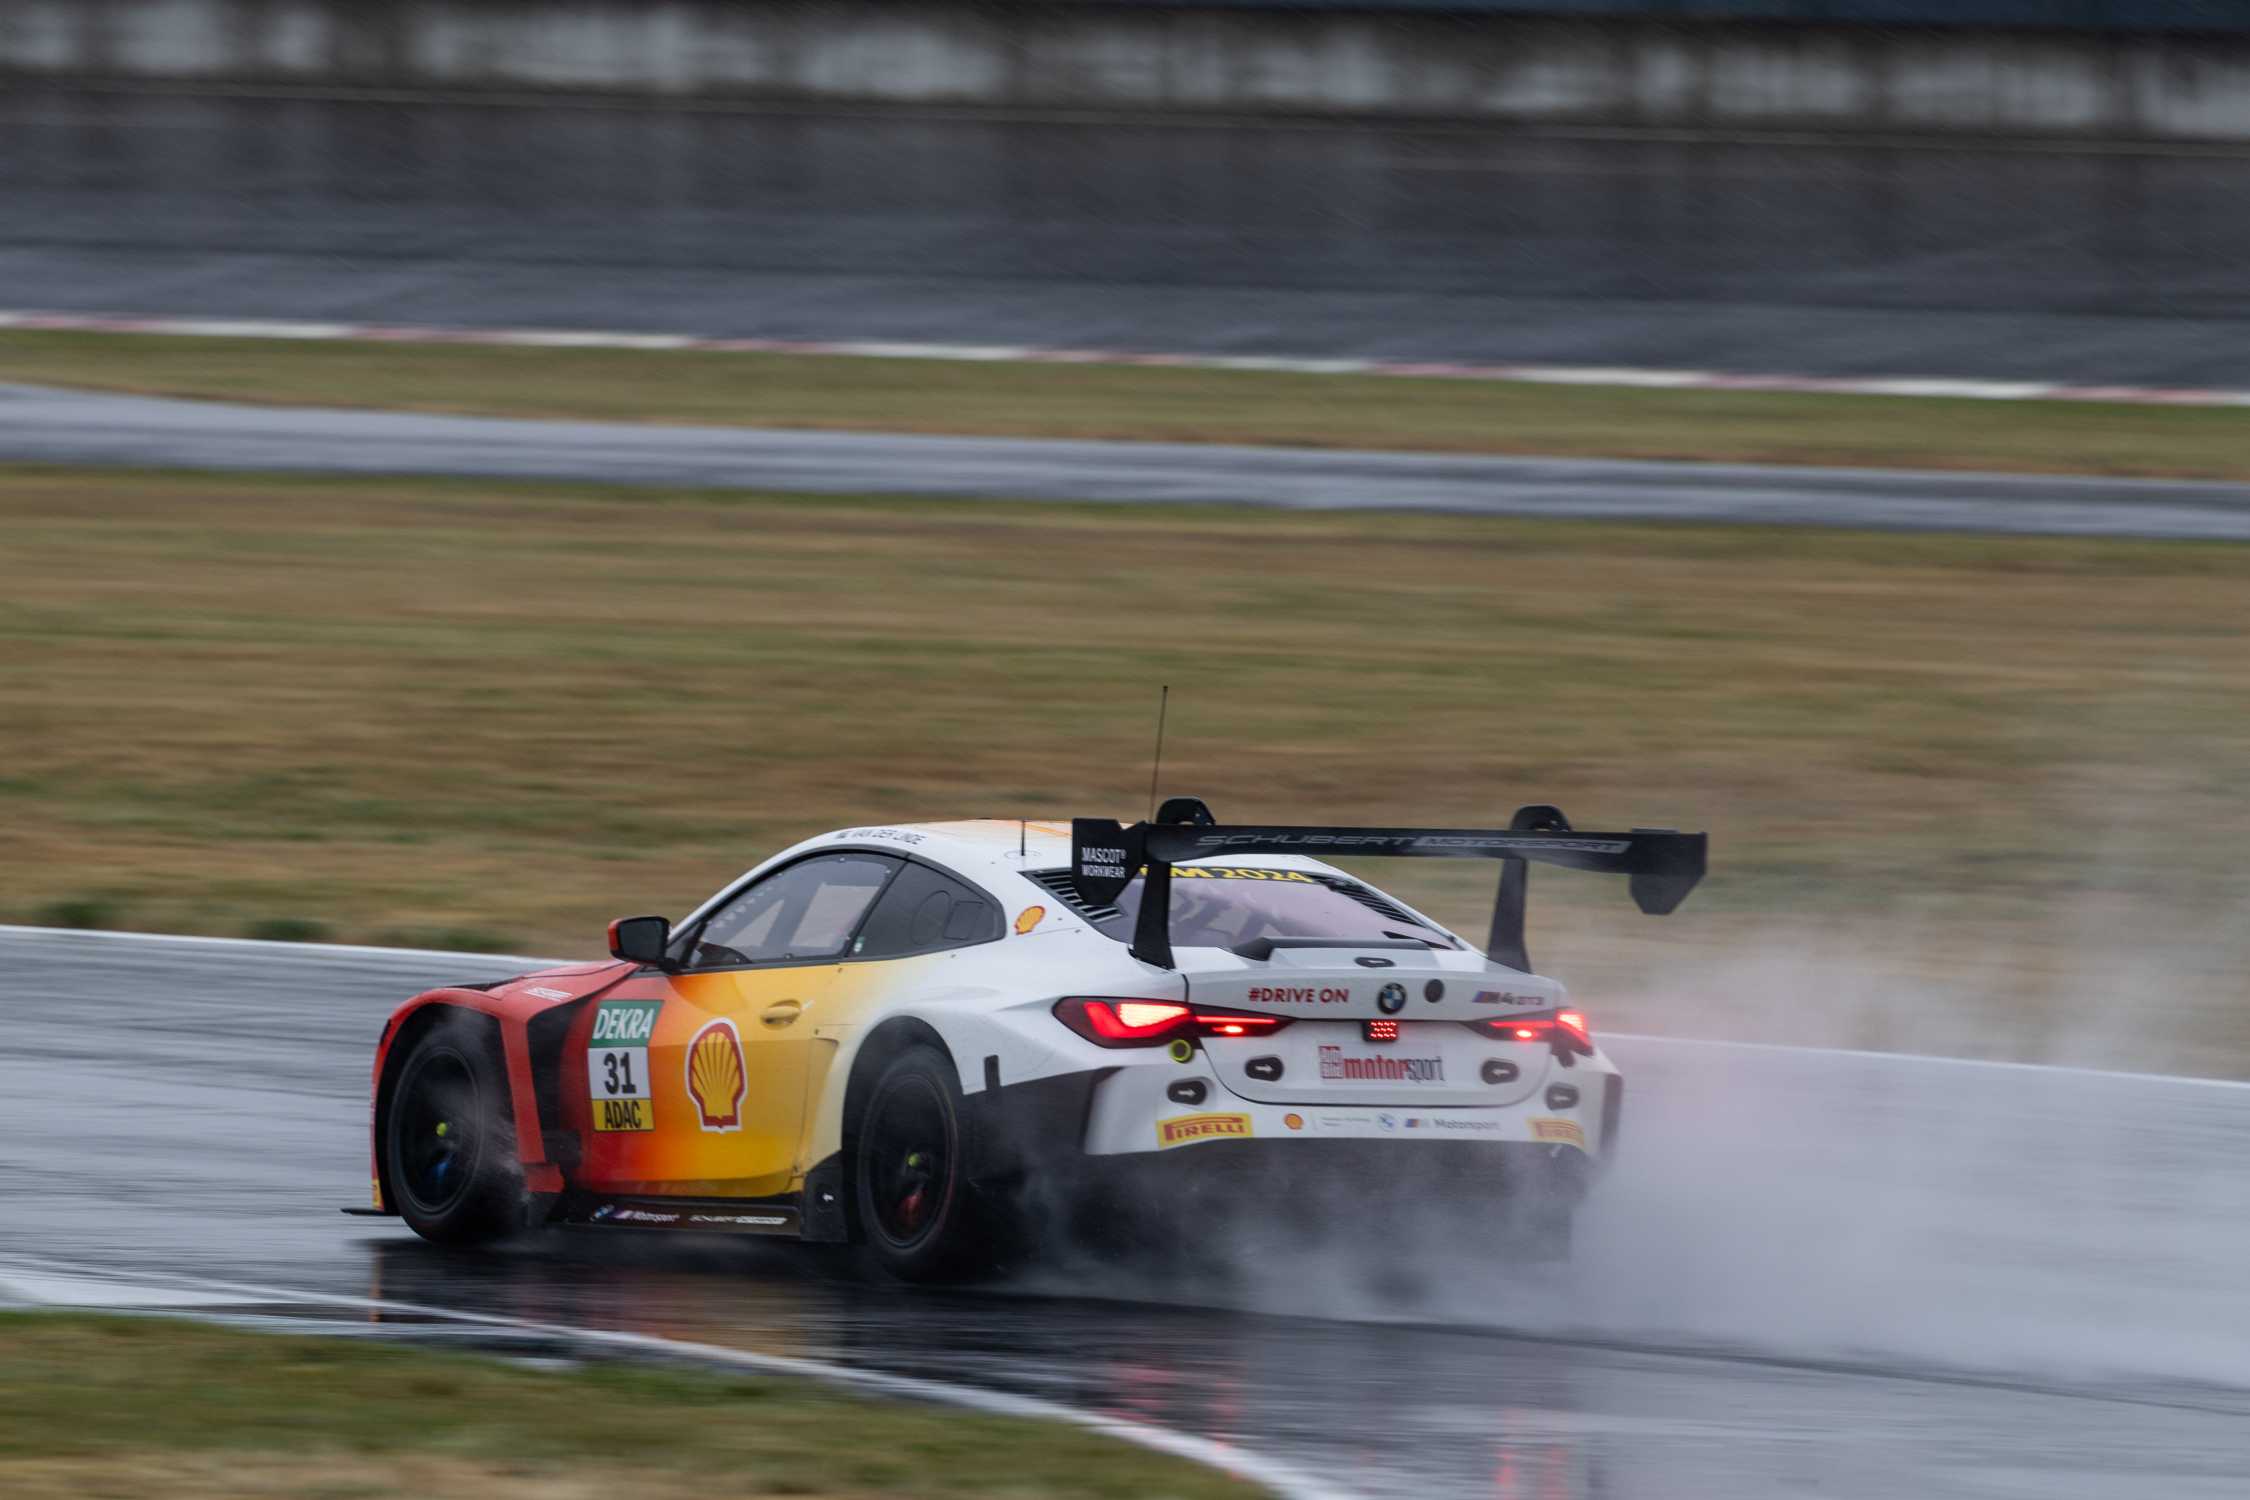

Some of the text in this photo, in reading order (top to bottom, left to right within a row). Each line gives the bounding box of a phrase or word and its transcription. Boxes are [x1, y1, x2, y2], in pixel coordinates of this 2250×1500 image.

[1196, 834, 1416, 847] SCHUBERT
[1248, 987, 1349, 1003] #DRIVE ON
[592, 1008, 656, 1040] DEKRA
[603, 1052, 637, 1095] 31
[1343, 1055, 1446, 1083] motorsport
[604, 1100, 642, 1129] ADAC
[1164, 1116, 1246, 1142] PIRELLI
